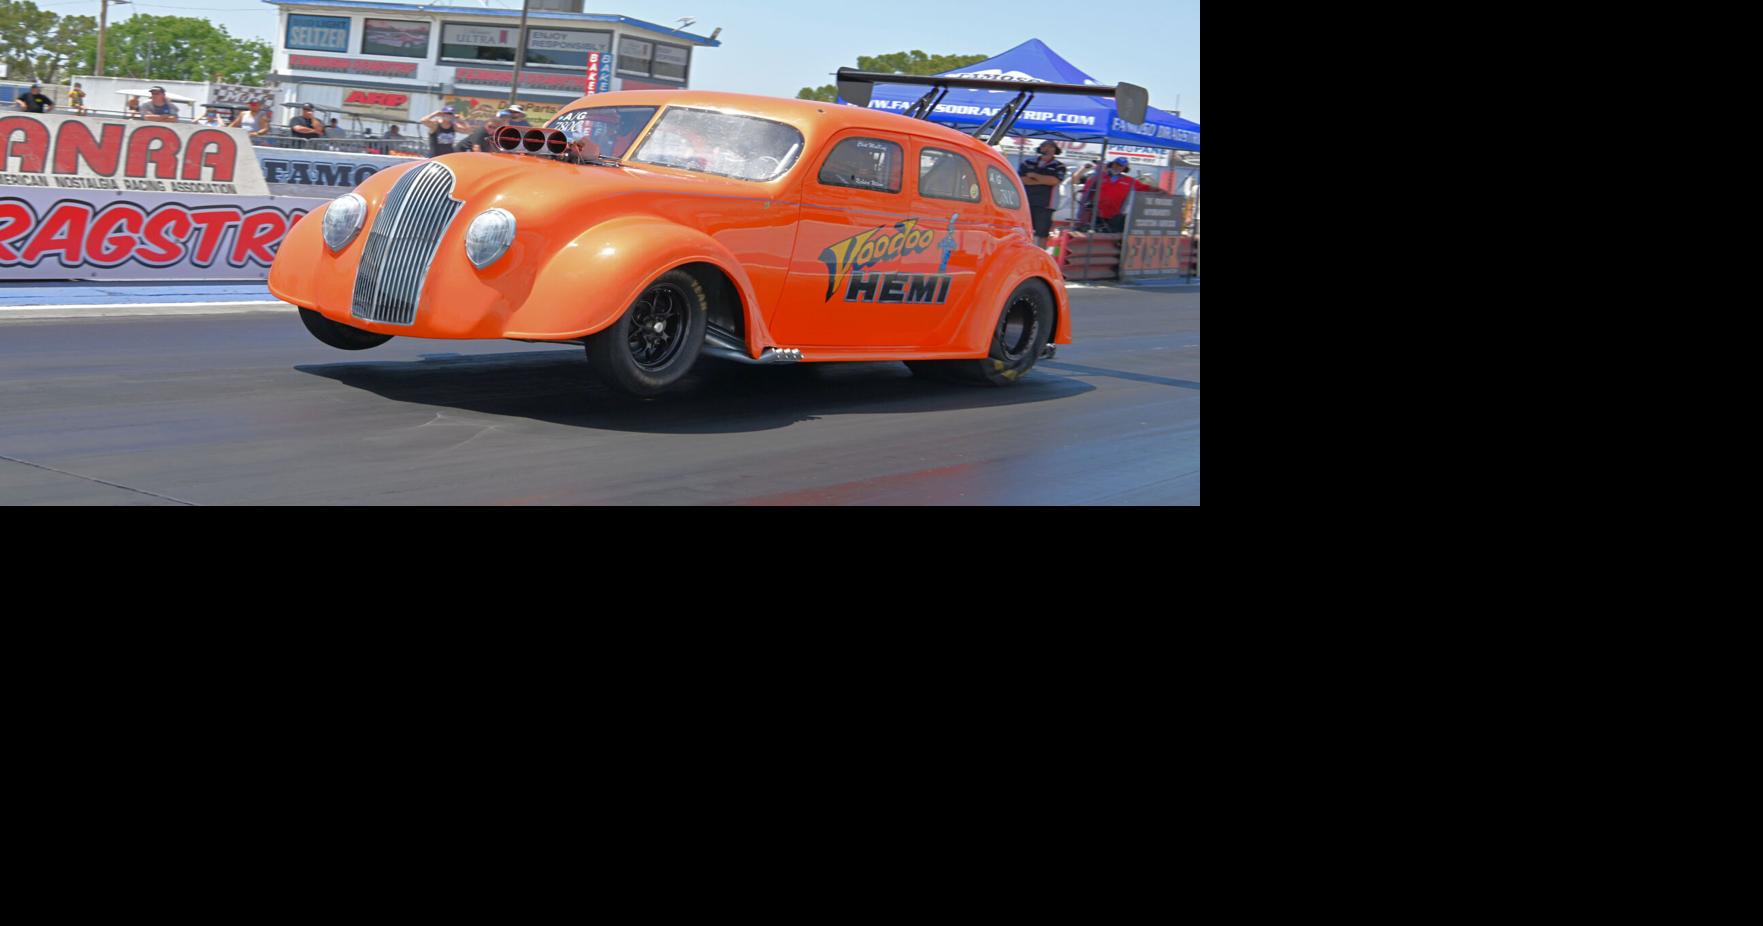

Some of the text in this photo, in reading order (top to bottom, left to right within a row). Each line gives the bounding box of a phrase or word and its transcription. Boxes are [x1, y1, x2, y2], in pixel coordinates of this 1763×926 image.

[290, 27, 346, 49] SELTZER
[456, 34, 496, 44] ULTRA
[532, 32, 567, 41] ENJOY
[531, 40, 607, 51] RESPONSIBLY
[344, 90, 408, 107] ARP
[0, 115, 237, 183] ANRA
[56, 177, 119, 190] NOSTALGIA
[124, 179, 165, 192] RACING
[171, 181, 237, 195] ASSOCIATION
[844, 271, 952, 305] HEMI
